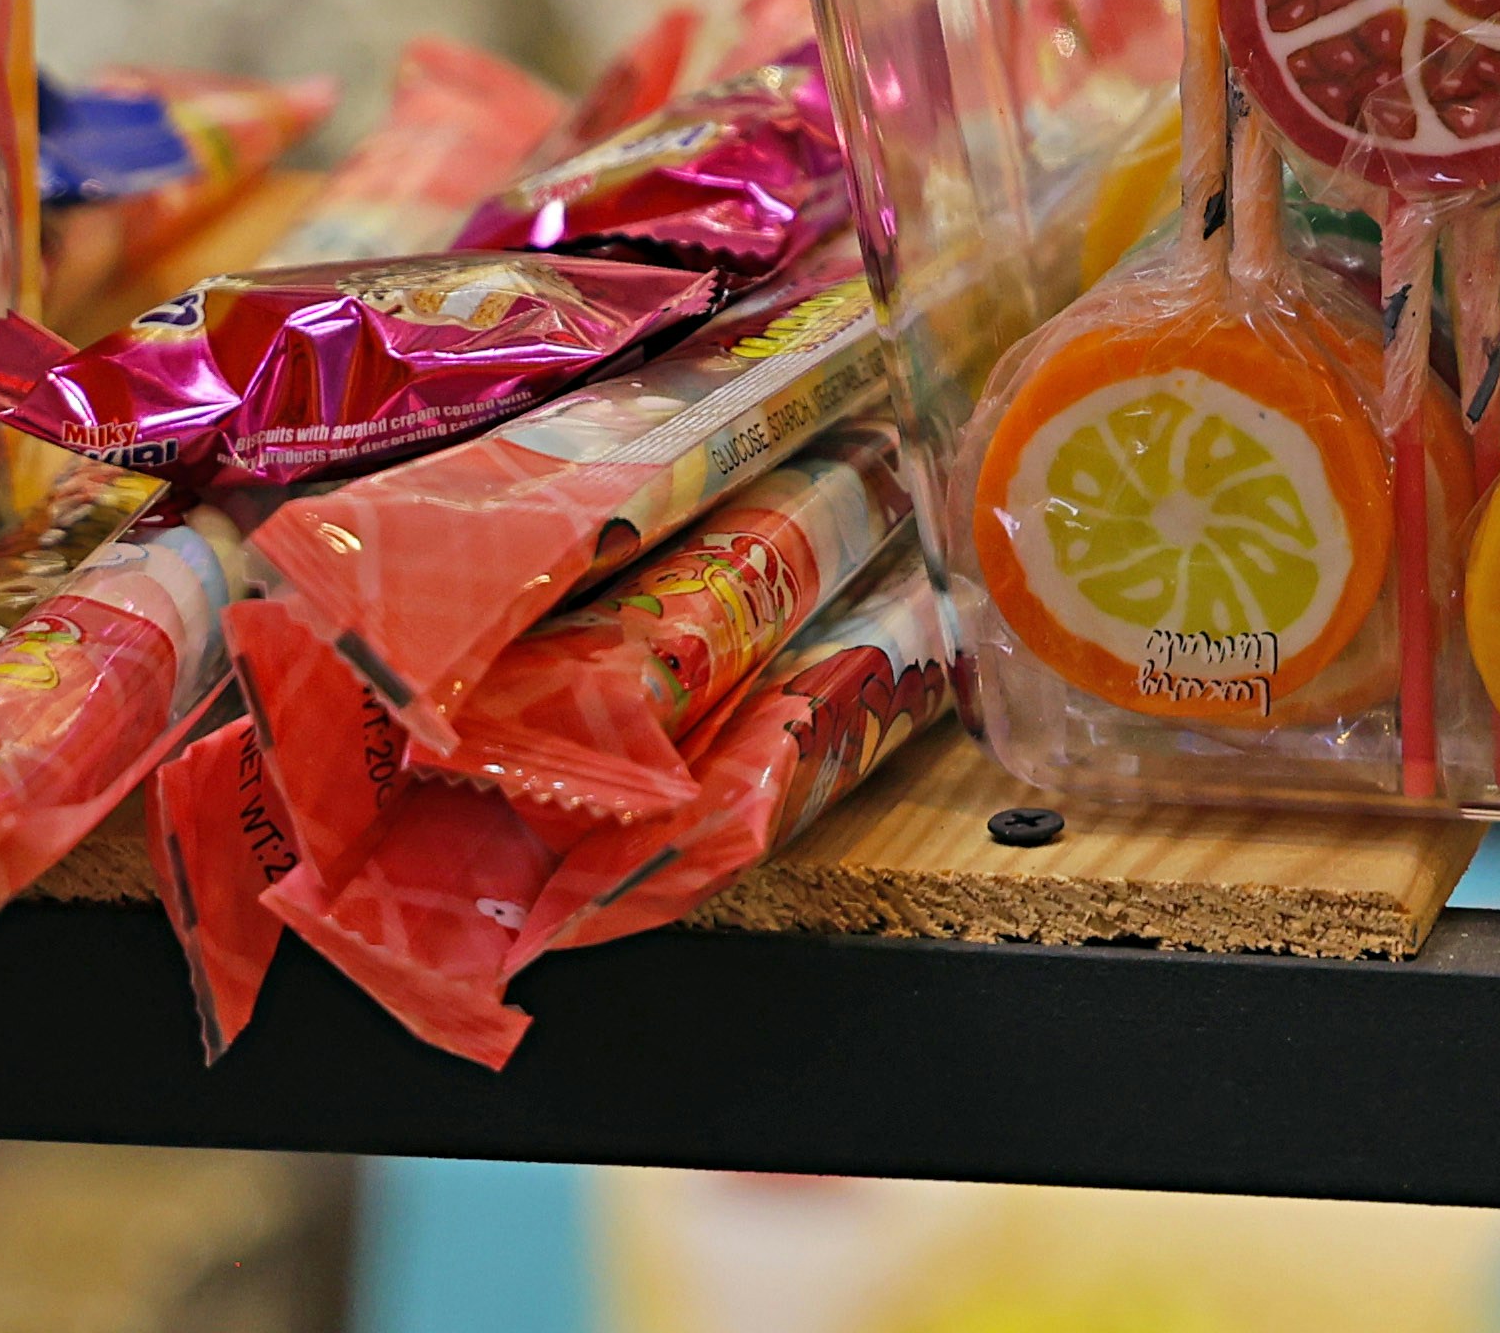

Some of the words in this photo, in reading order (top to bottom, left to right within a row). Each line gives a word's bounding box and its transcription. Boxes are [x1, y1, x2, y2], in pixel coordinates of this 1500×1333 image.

[62, 420, 138, 448] Milky
[235, 428, 294, 452] Biscuits
[296, 425, 329, 444] with
[332, 416, 387, 441] aerated
[390, 406, 441, 429] cream
[497, 389, 533, 409] with
[261, 448, 327, 468] products
[329, 444, 358, 460] and
[360, 424, 449, 452] decorating
[1135, 659, 1273, 719] Luxury
[239, 724, 264, 793] NET
[238, 797, 303, 886] WT:2
